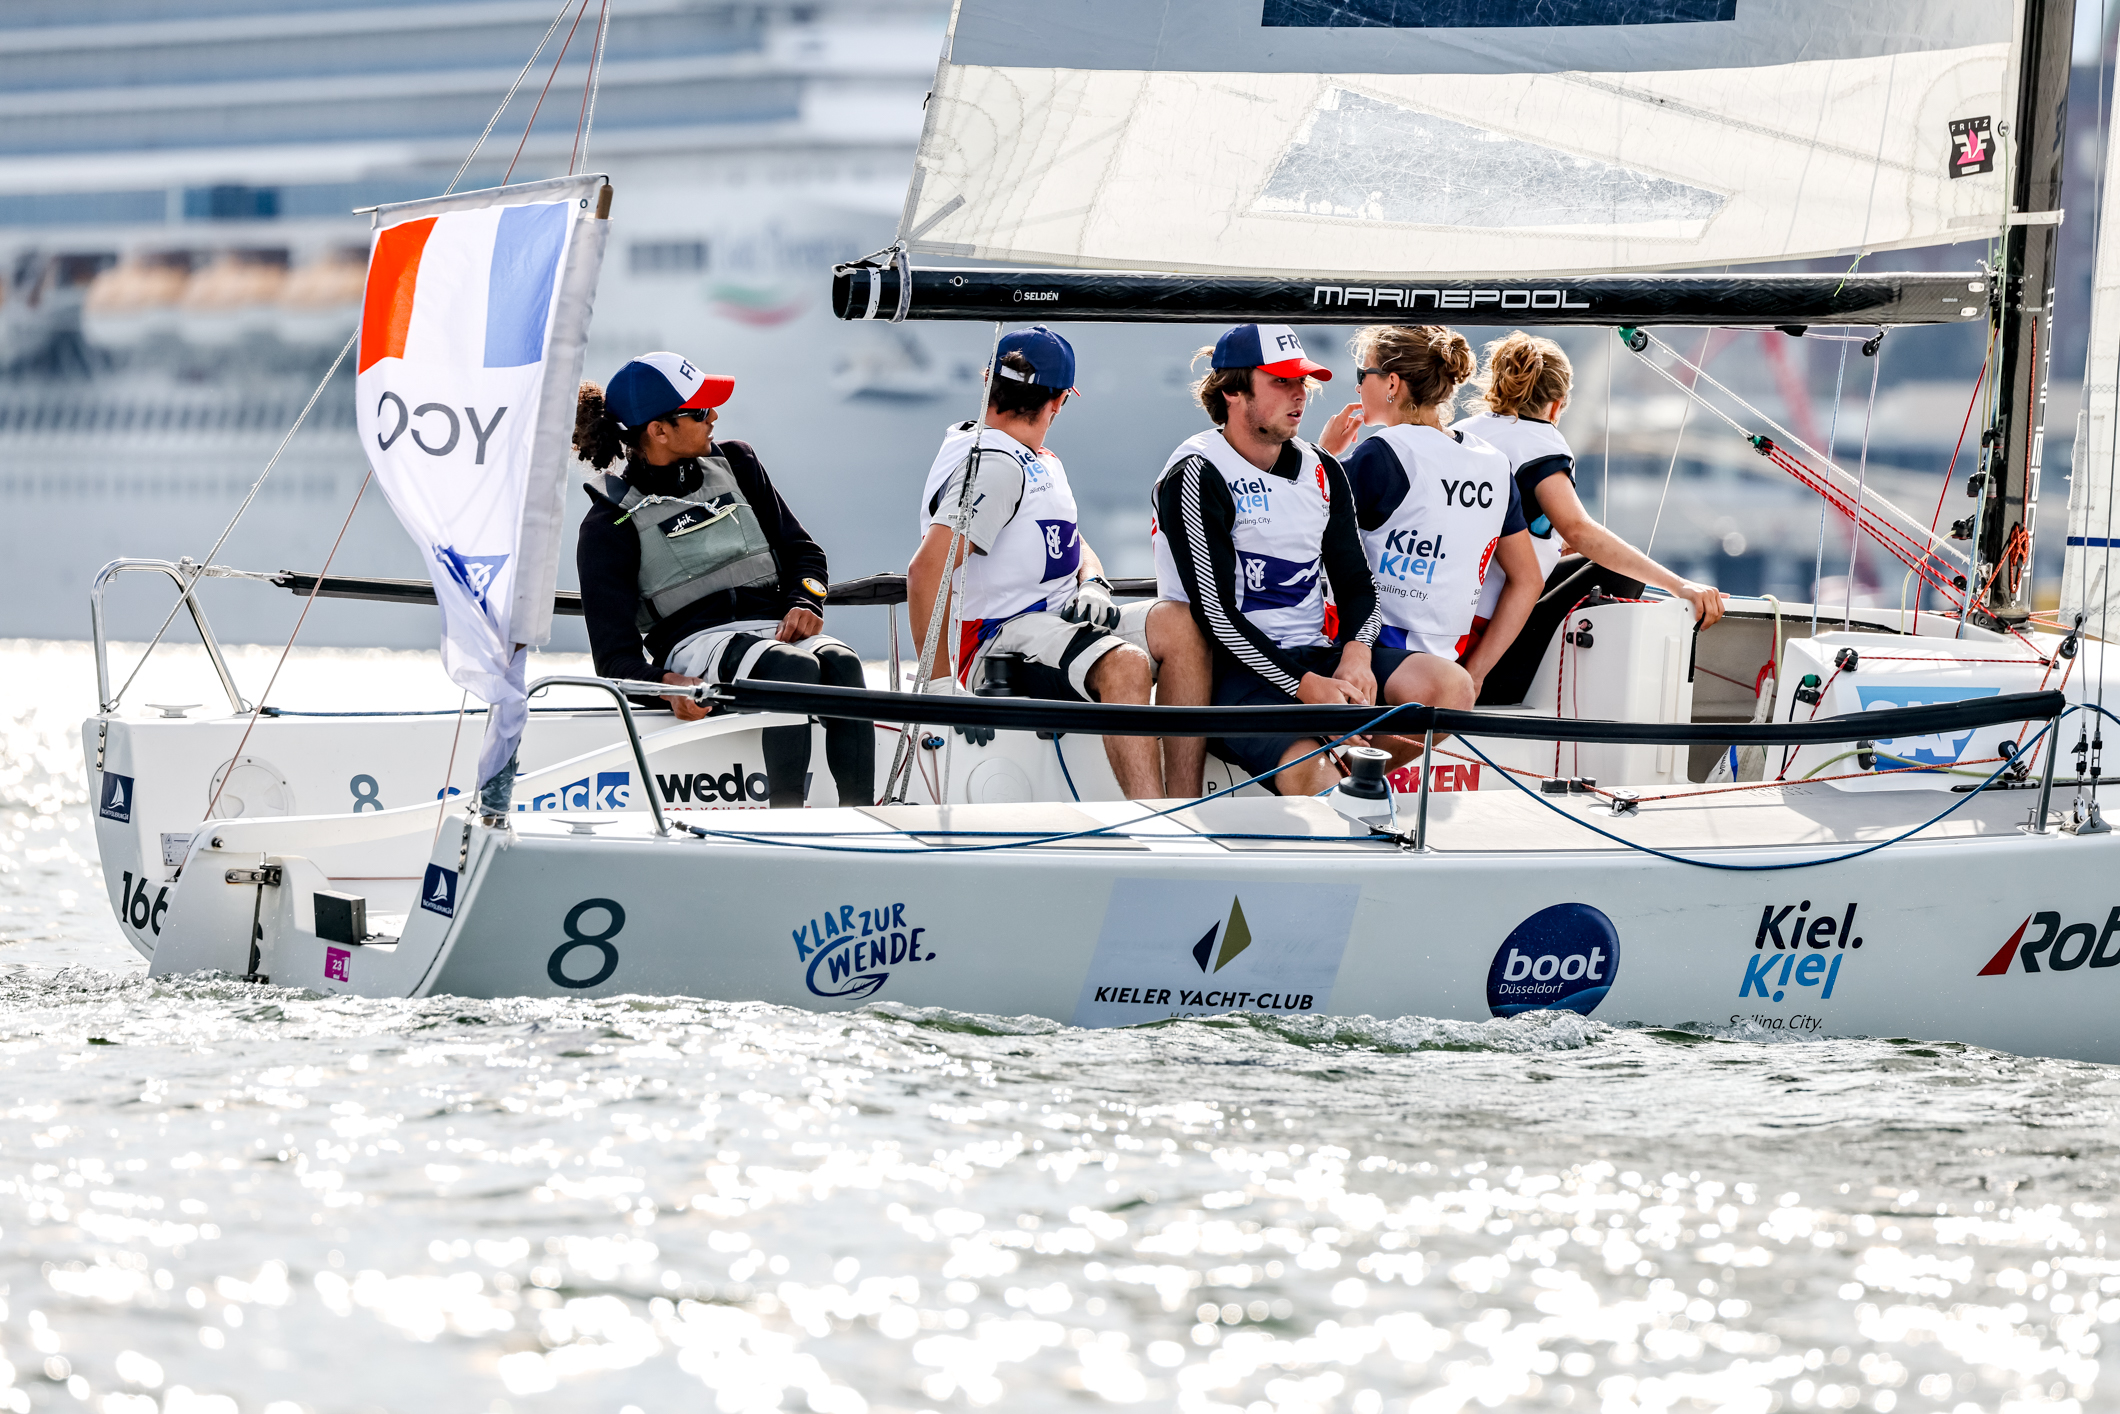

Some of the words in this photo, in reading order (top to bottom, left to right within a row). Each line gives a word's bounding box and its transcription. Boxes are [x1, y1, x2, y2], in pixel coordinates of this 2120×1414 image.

[1951, 119, 1988, 132] FRITZ
[1024, 290, 1059, 301] SELDÉN
[1313, 286, 1590, 309] MARINEPOOL
[1227, 477, 1273, 496] Kiel.
[1441, 479, 1494, 509] YCC
[1385, 528, 1446, 560] Kiel.
[1386, 763, 1481, 794] RKEN
[792, 905, 856, 962] KLAR
[858, 903, 907, 937] ZUR
[1755, 900, 1863, 950] Kiel.
[546, 897, 626, 989] 8
[828, 928, 936, 983] WENDE.
[332, 958, 343, 972] 23
[1503, 947, 1606, 982] boot
[1094, 986, 1171, 1005] KIELER
[1179, 990, 1314, 1011] YACHT-CLUB
[1499, 982, 1565, 994] Düsseldorf
